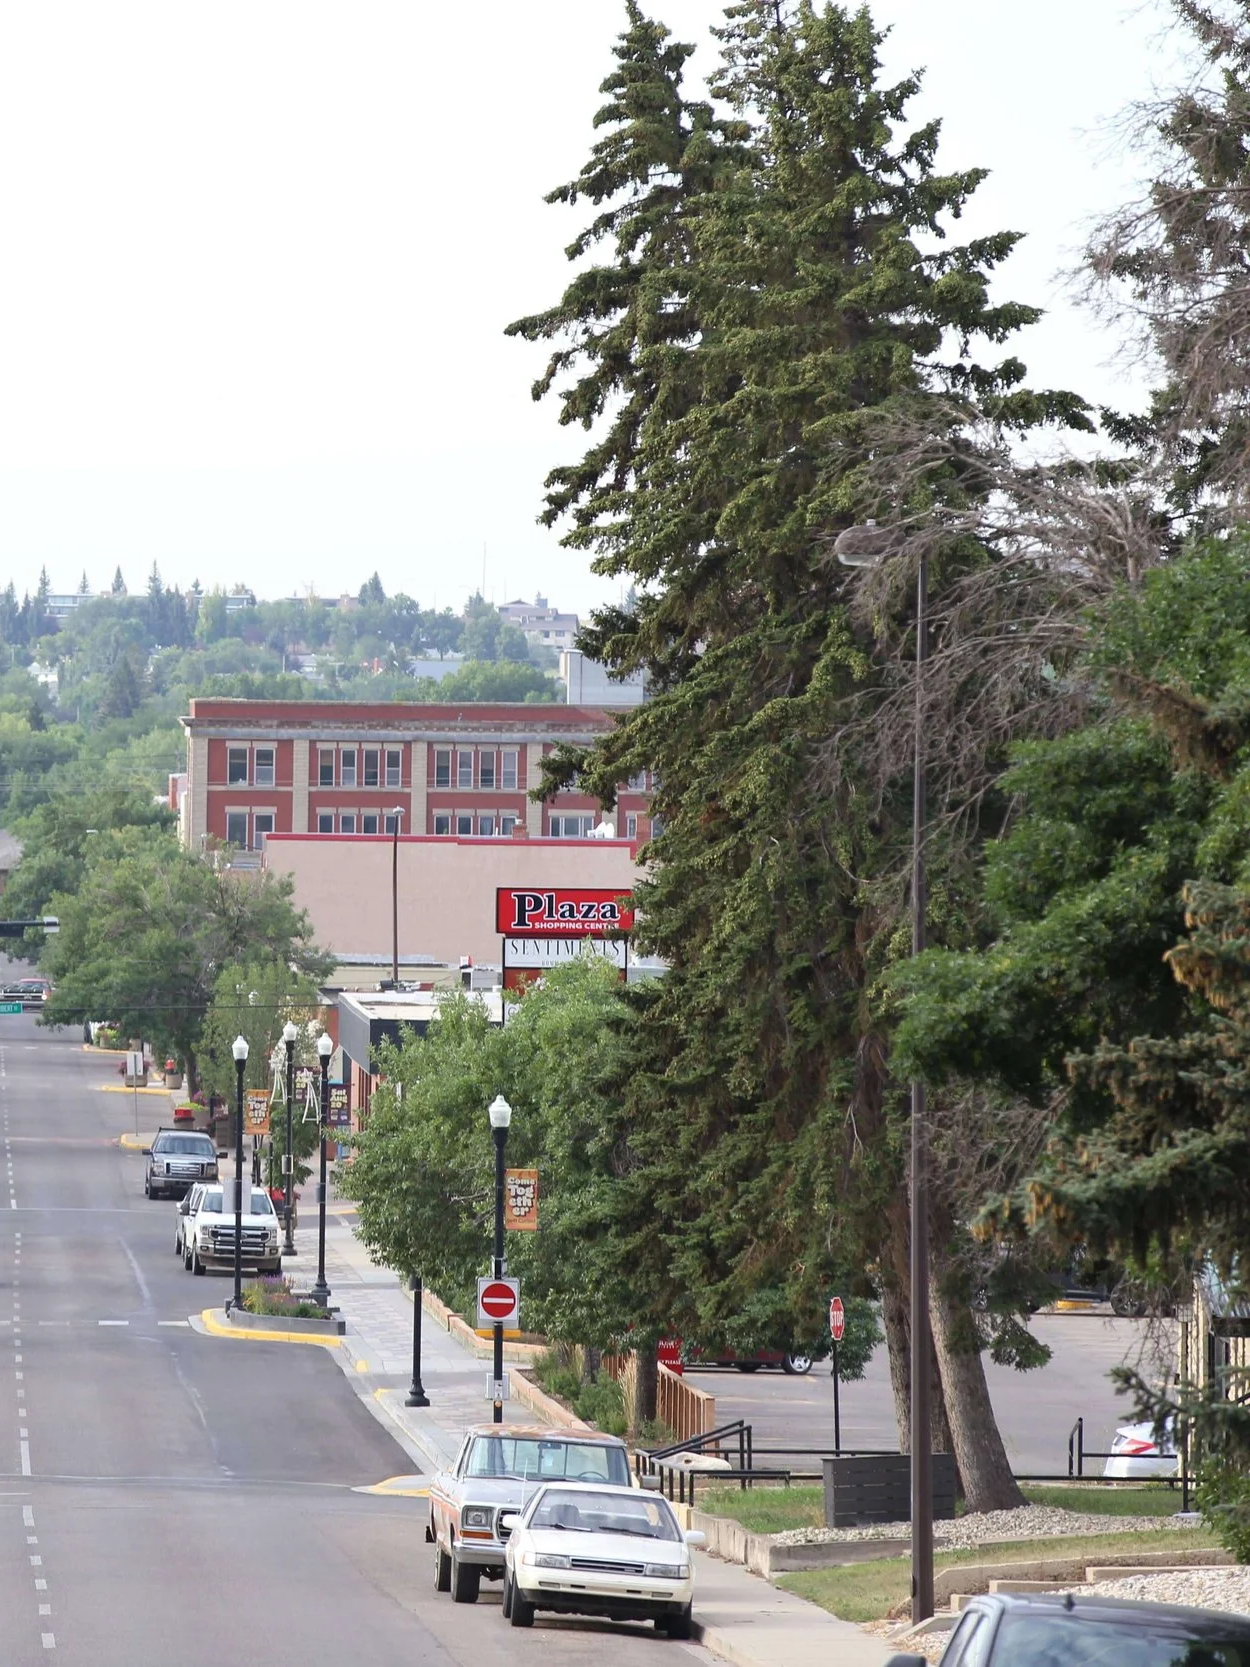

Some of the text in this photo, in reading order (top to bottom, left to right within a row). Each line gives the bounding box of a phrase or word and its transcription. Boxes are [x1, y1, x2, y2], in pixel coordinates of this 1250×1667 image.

[511, 892, 620, 928] Plaza
[248, 1101, 266, 1111] Tog
[249, 1110, 266, 1118] eth
[508, 1177, 535, 1185] Come
[508, 1185, 534, 1198] Tog
[509, 1196, 532, 1207] eth
[512, 1207, 530, 1216] er
[830, 1310, 844, 1327] STOP
